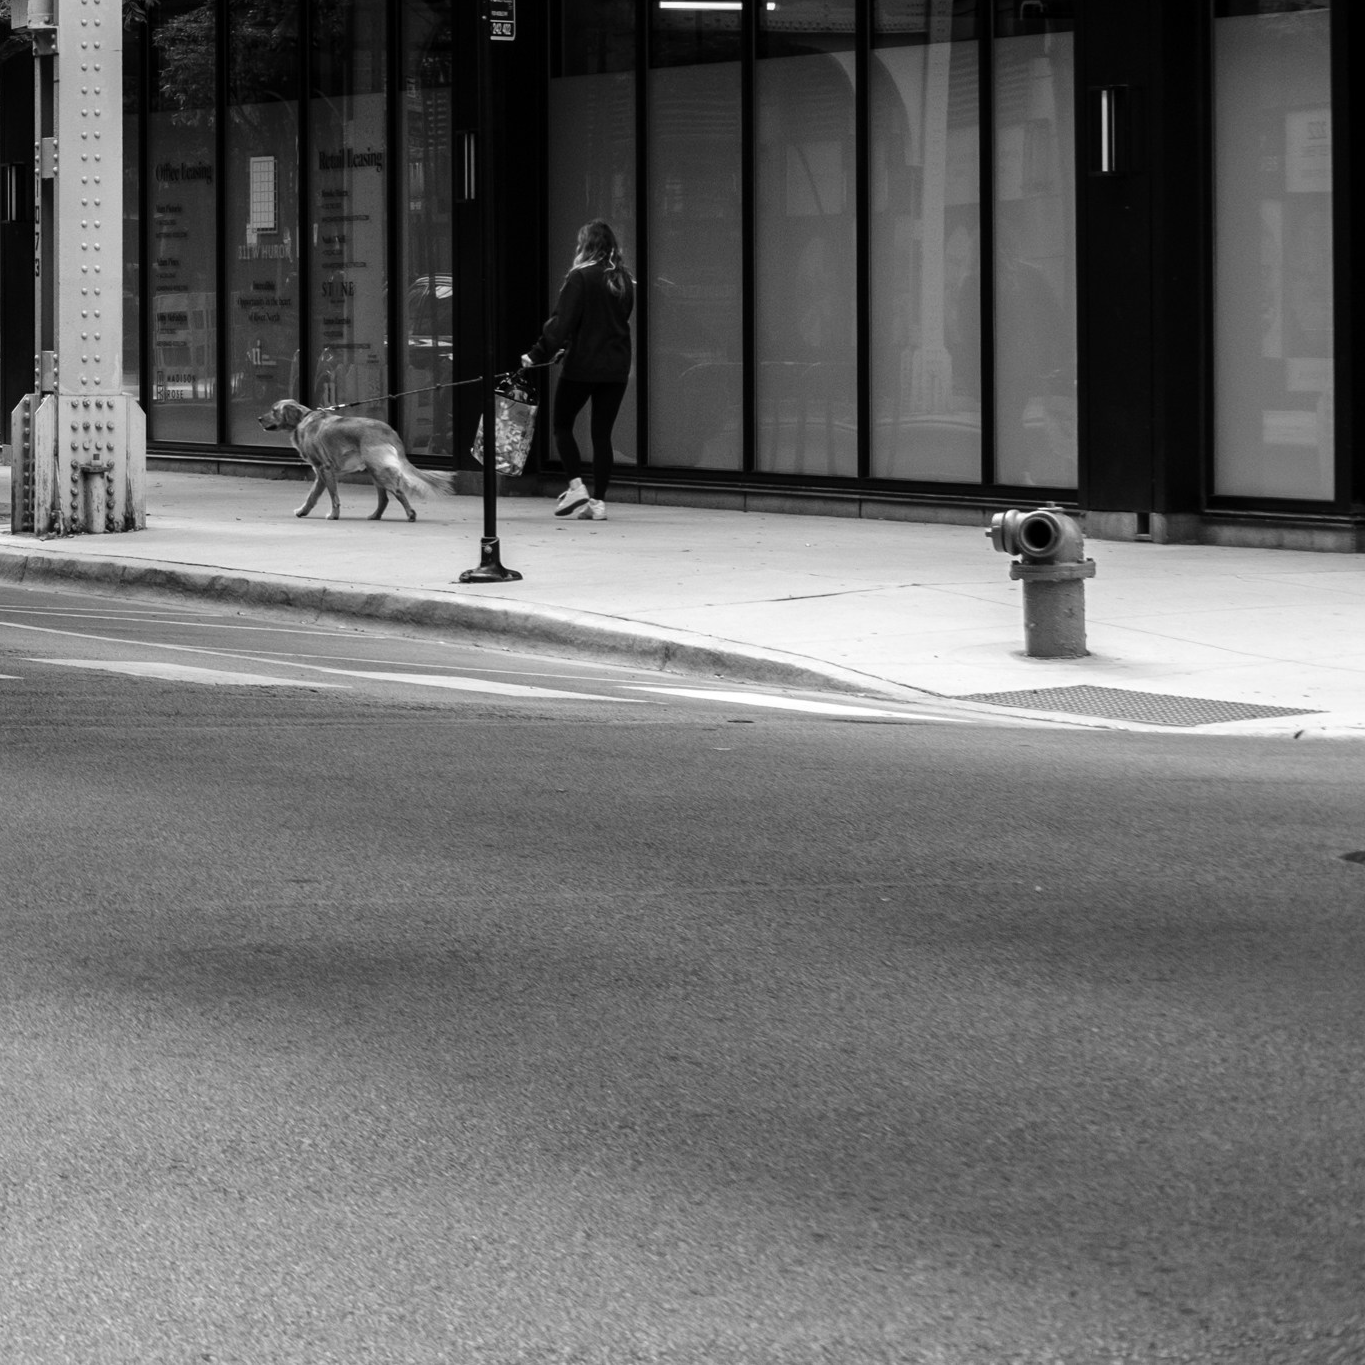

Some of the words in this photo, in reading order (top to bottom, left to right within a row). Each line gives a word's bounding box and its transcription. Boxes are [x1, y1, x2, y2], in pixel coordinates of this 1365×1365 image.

[319, 148, 344, 170] Retail
[348, 147, 382, 172] Leasing
[155, 163, 180, 182] Office
[181, 162, 212, 185] Leasing
